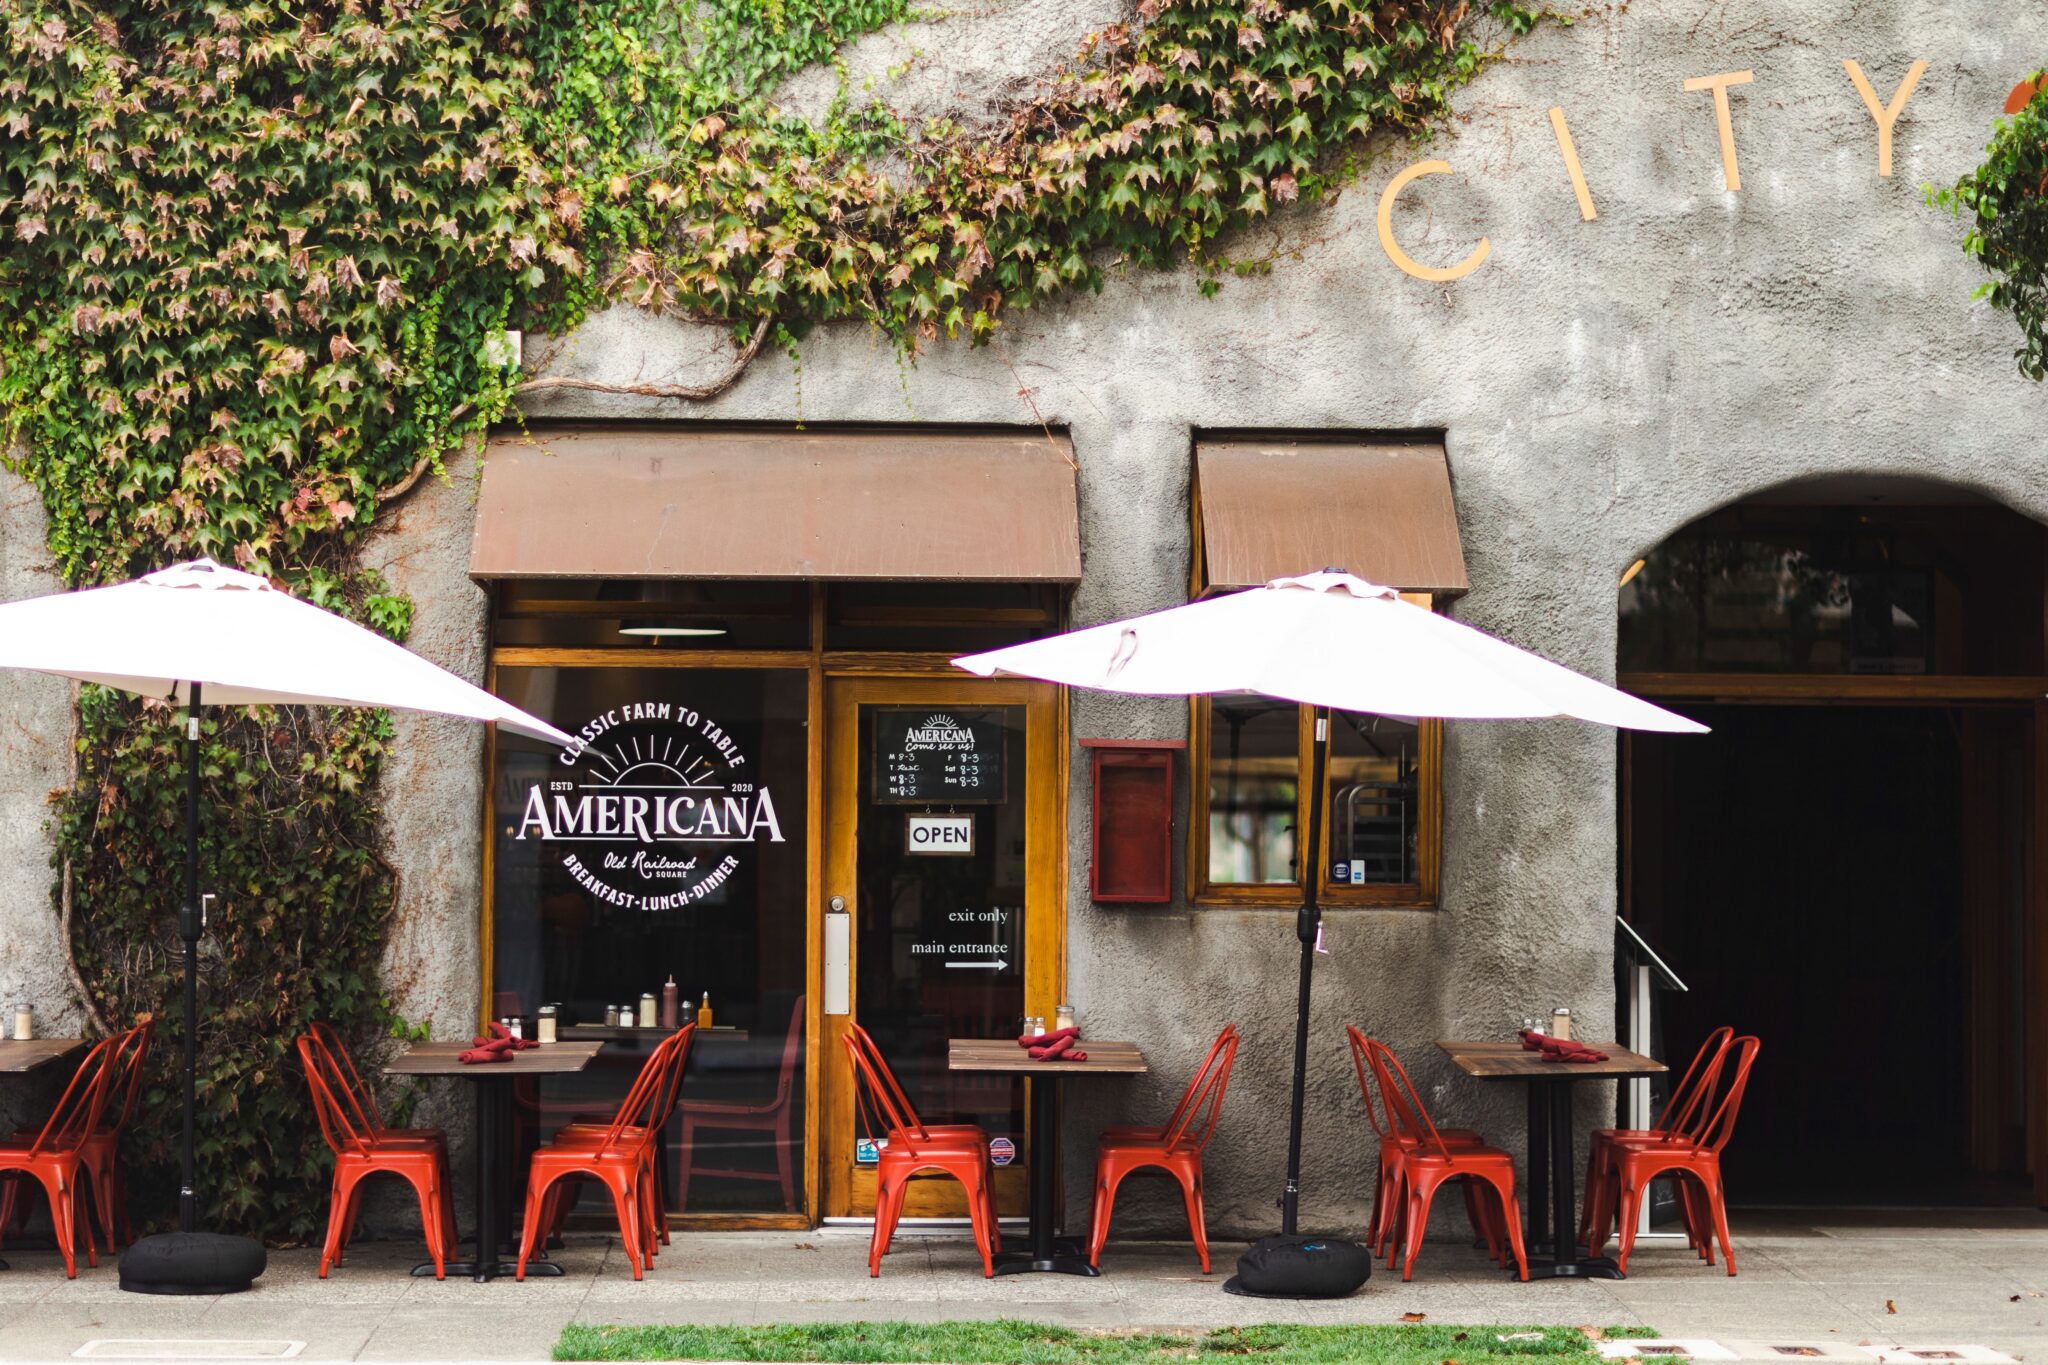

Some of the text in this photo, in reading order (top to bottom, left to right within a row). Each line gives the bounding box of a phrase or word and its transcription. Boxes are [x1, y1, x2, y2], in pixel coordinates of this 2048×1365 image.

[1376, 57, 1929, 282] CITY
[559, 702, 745, 768] CLASSIC FARM TO TABLE
[905, 727, 975, 743] AMERICANA
[905, 743, 974, 752] Come see us!
[898, 753, 915, 762] 8-3
[960, 753, 979, 763] 8-3
[960, 765, 979, 775] 8-3
[898, 774, 916, 785] 8-3
[944, 776, 979, 787] Sun 8-3
[550, 781, 573, 791] ESTD
[731, 783, 753, 793] 2020
[898, 786, 917, 796] 8-3
[515, 784, 786, 843] AMERICANA
[913, 826, 968, 843] OPEN
[604, 850, 697, 879] Old Railroad
[655, 870, 687, 878] SQUARE
[948, 908, 1008, 925] exit only
[911, 940, 1008, 953] main entrance
